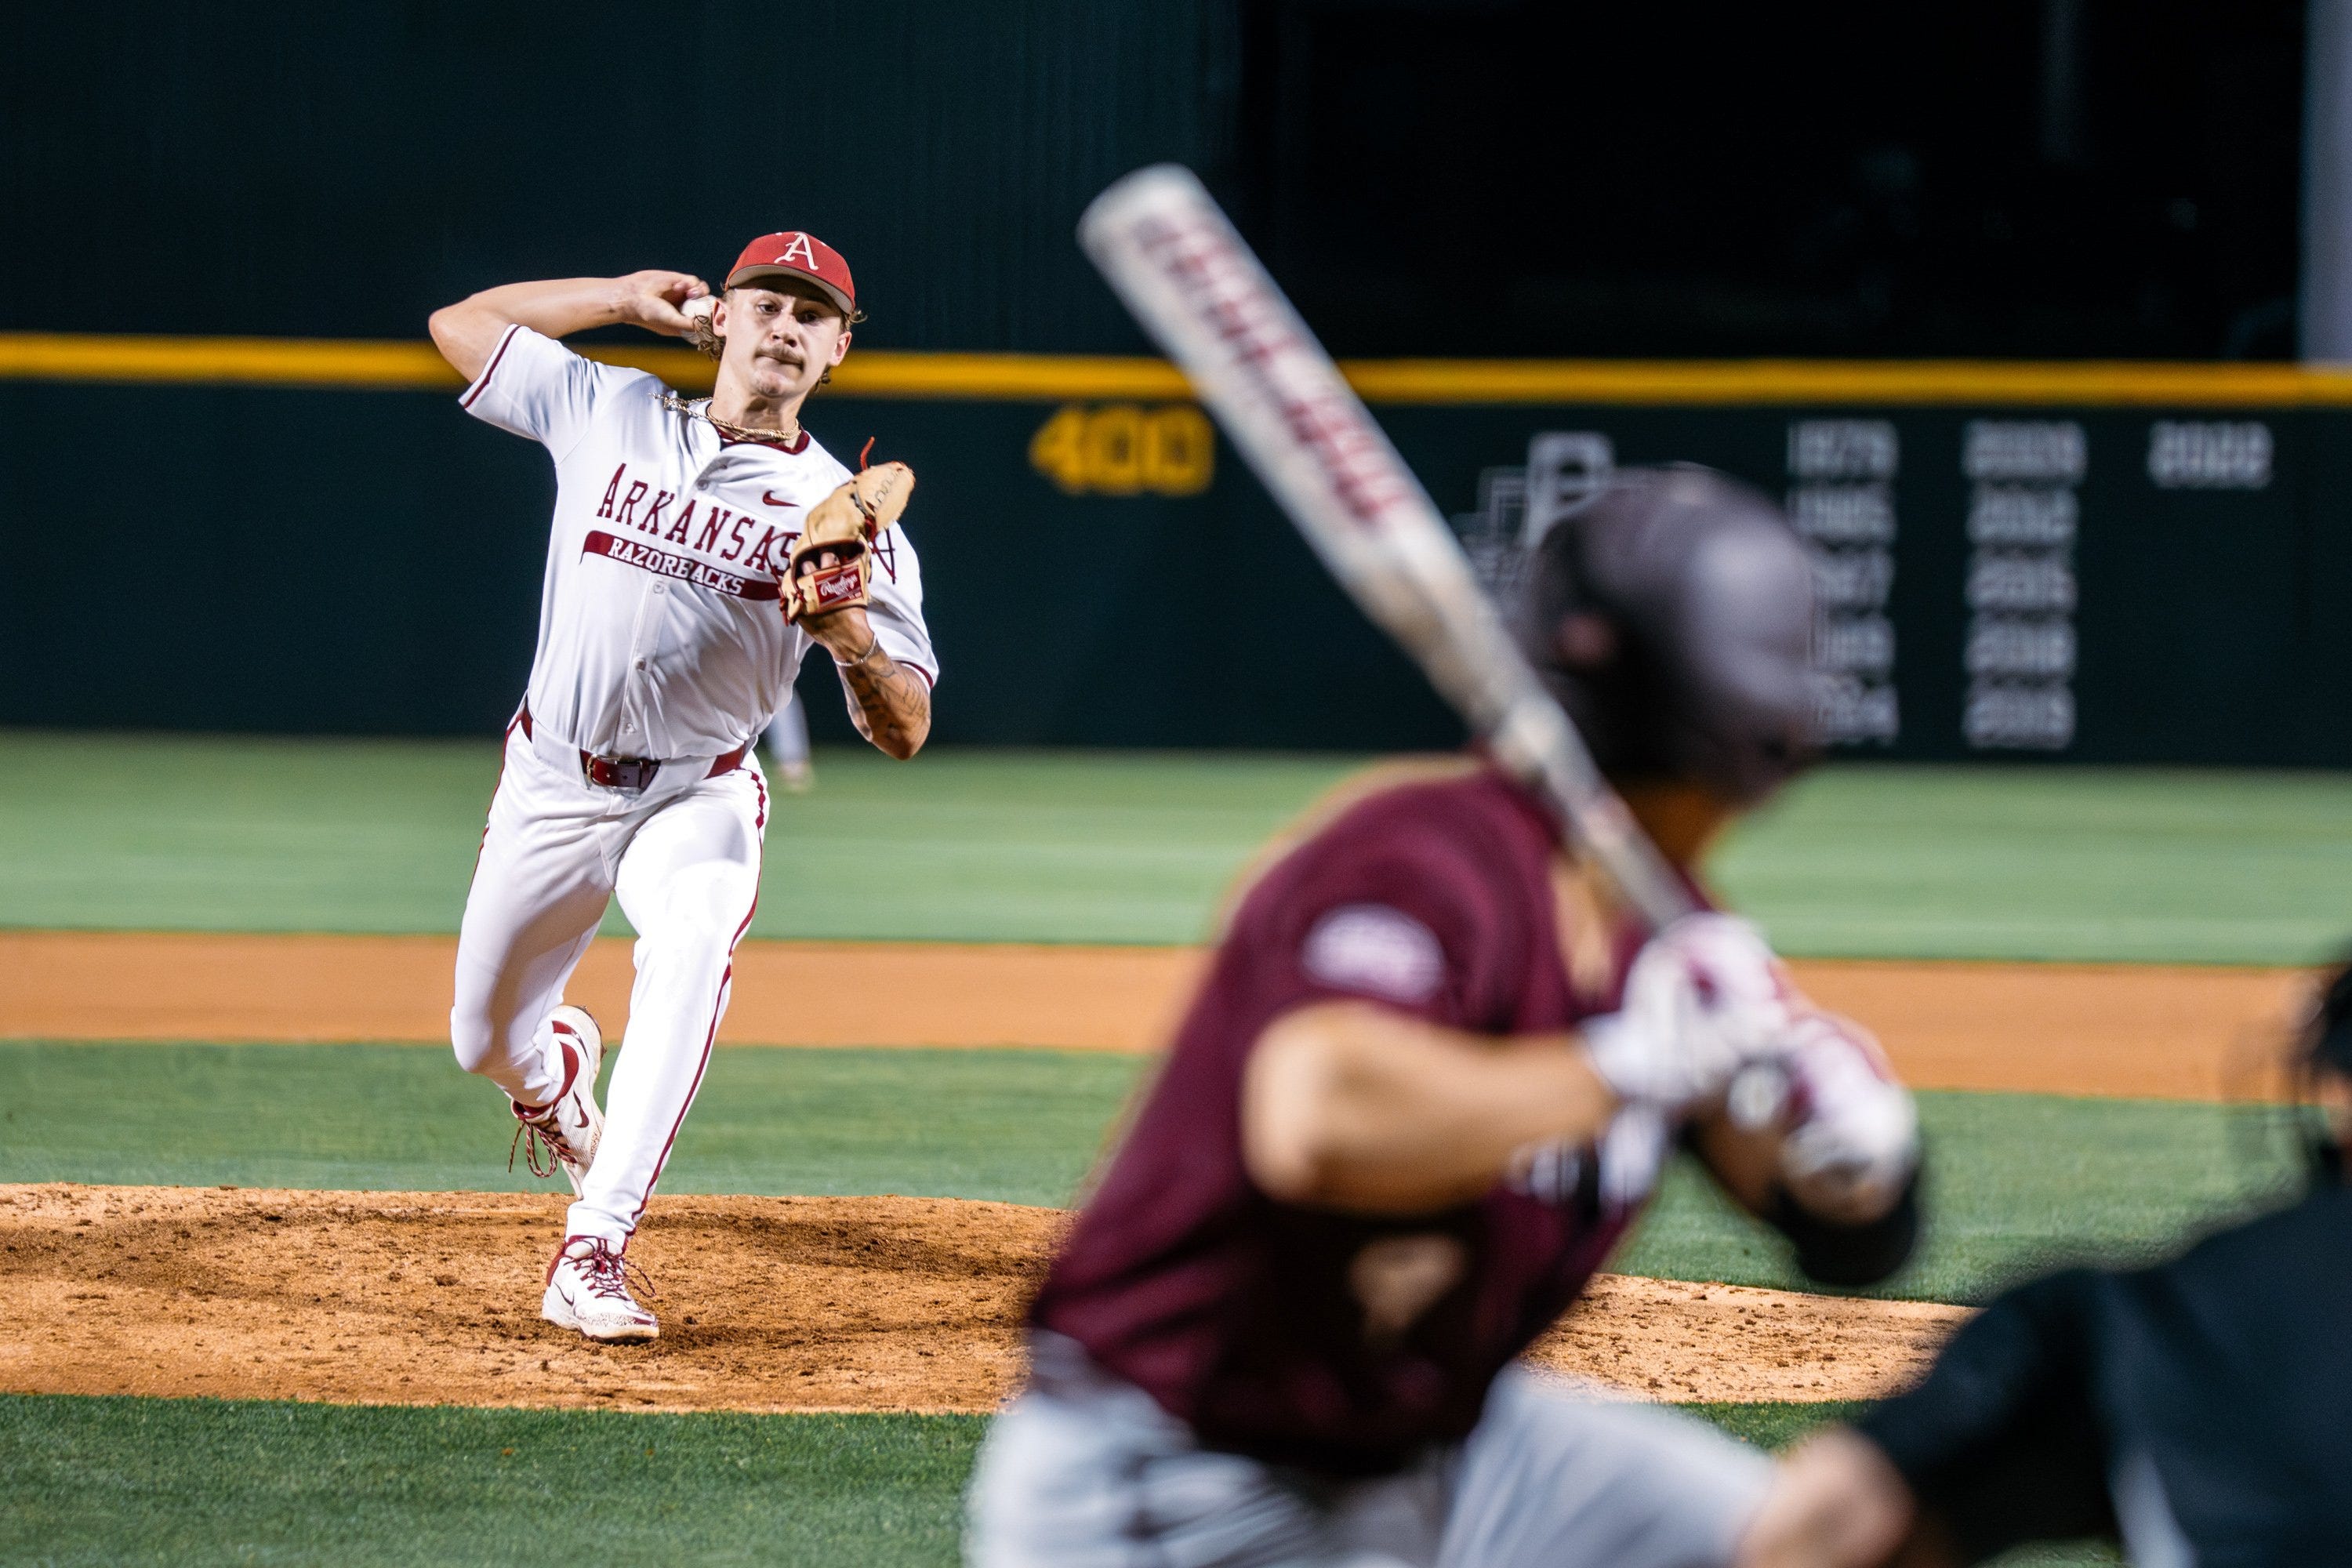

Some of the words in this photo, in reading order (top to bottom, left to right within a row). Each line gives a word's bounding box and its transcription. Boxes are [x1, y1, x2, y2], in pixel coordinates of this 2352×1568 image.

[774, 232, 819, 270] A
[1029, 405, 1215, 495] 400
[608, 538, 745, 595] RAZORBACKS
